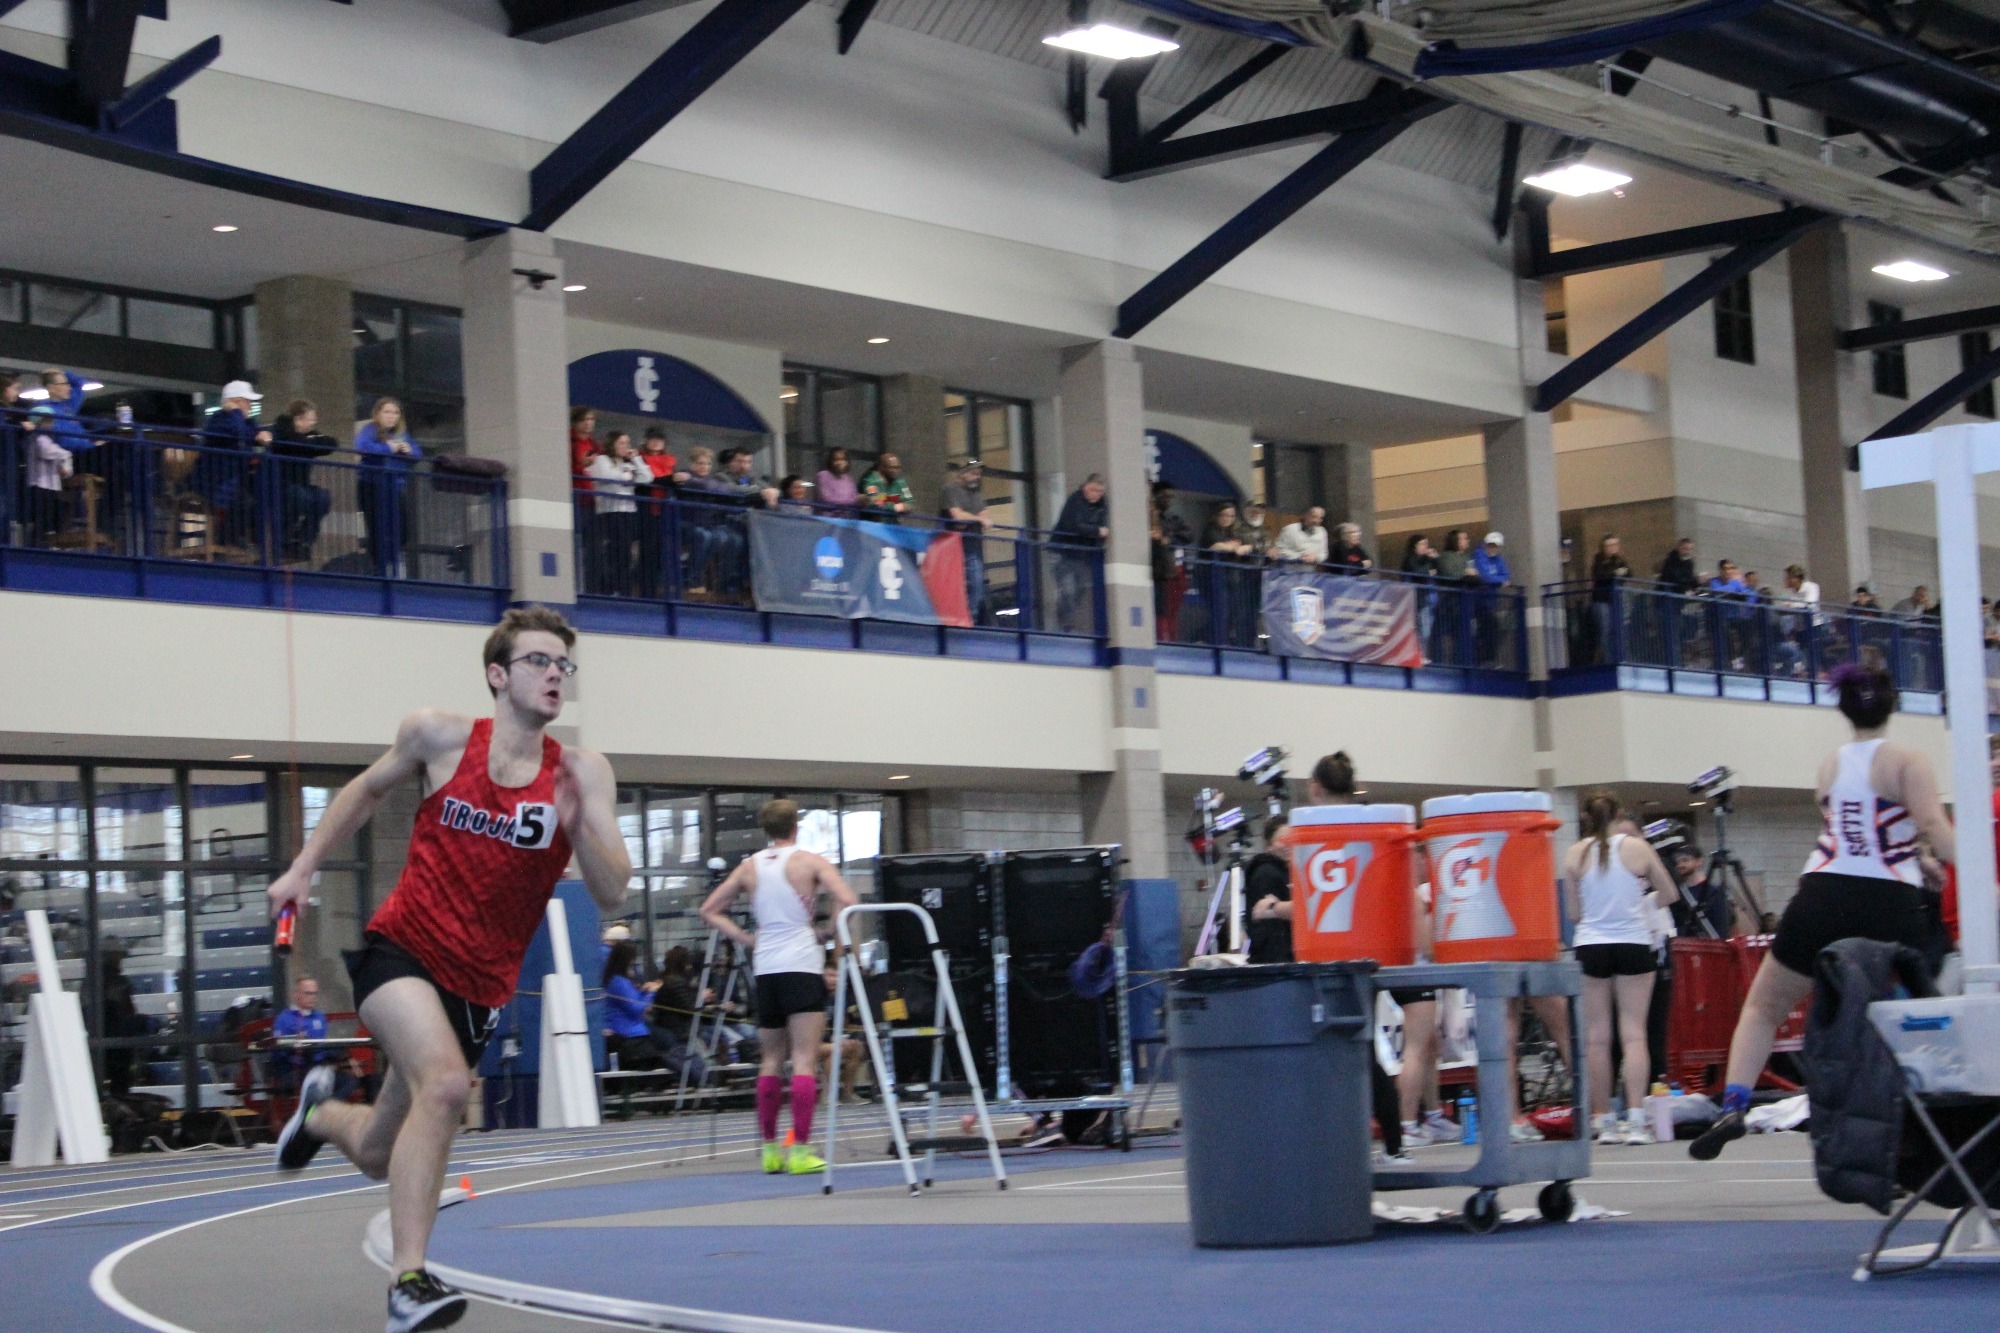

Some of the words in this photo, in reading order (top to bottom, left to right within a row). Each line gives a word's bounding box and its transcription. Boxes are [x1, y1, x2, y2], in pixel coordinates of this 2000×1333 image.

[440, 797, 517, 842] TROJA
[515, 805, 544, 846] 5
[1309, 849, 1347, 893] G
[1440, 846, 1482, 899] G
